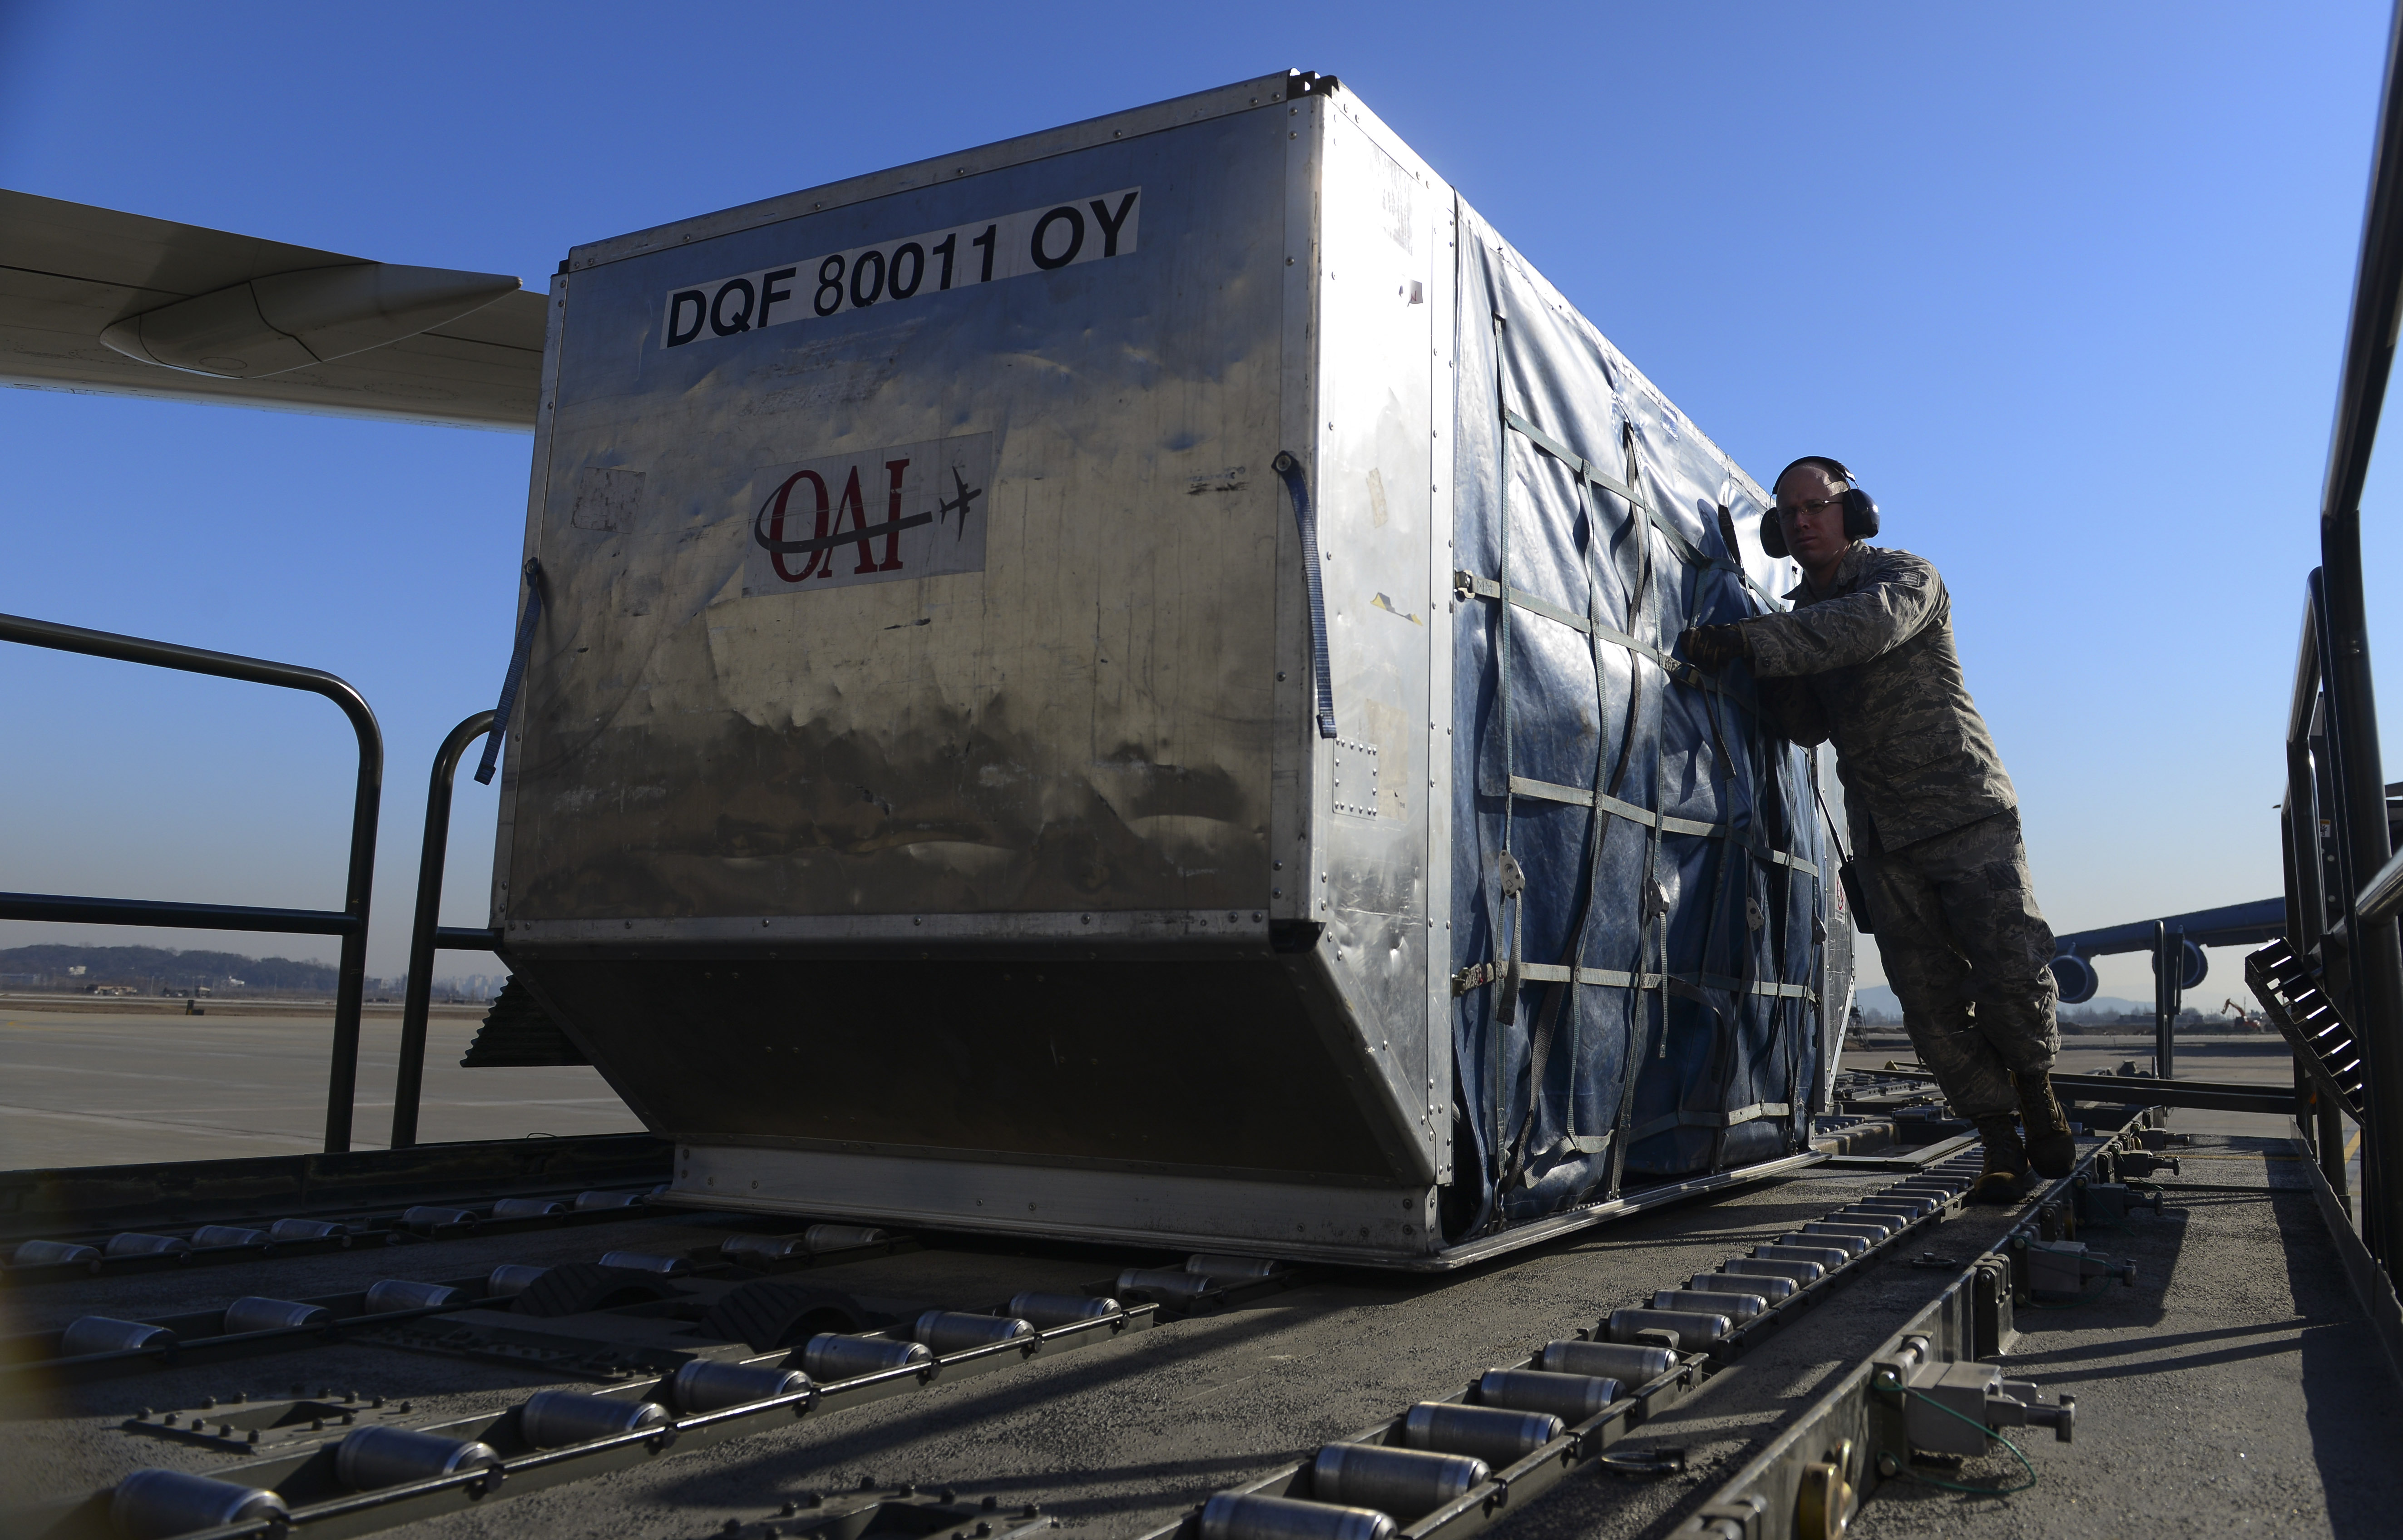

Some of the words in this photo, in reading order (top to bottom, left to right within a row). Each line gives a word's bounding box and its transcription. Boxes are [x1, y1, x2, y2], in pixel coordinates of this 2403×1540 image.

[667, 267, 796, 348] DQF
[813, 224, 997, 317] 80011
[1030, 191, 1139, 270] OY
[770, 458, 910, 582] OAI
